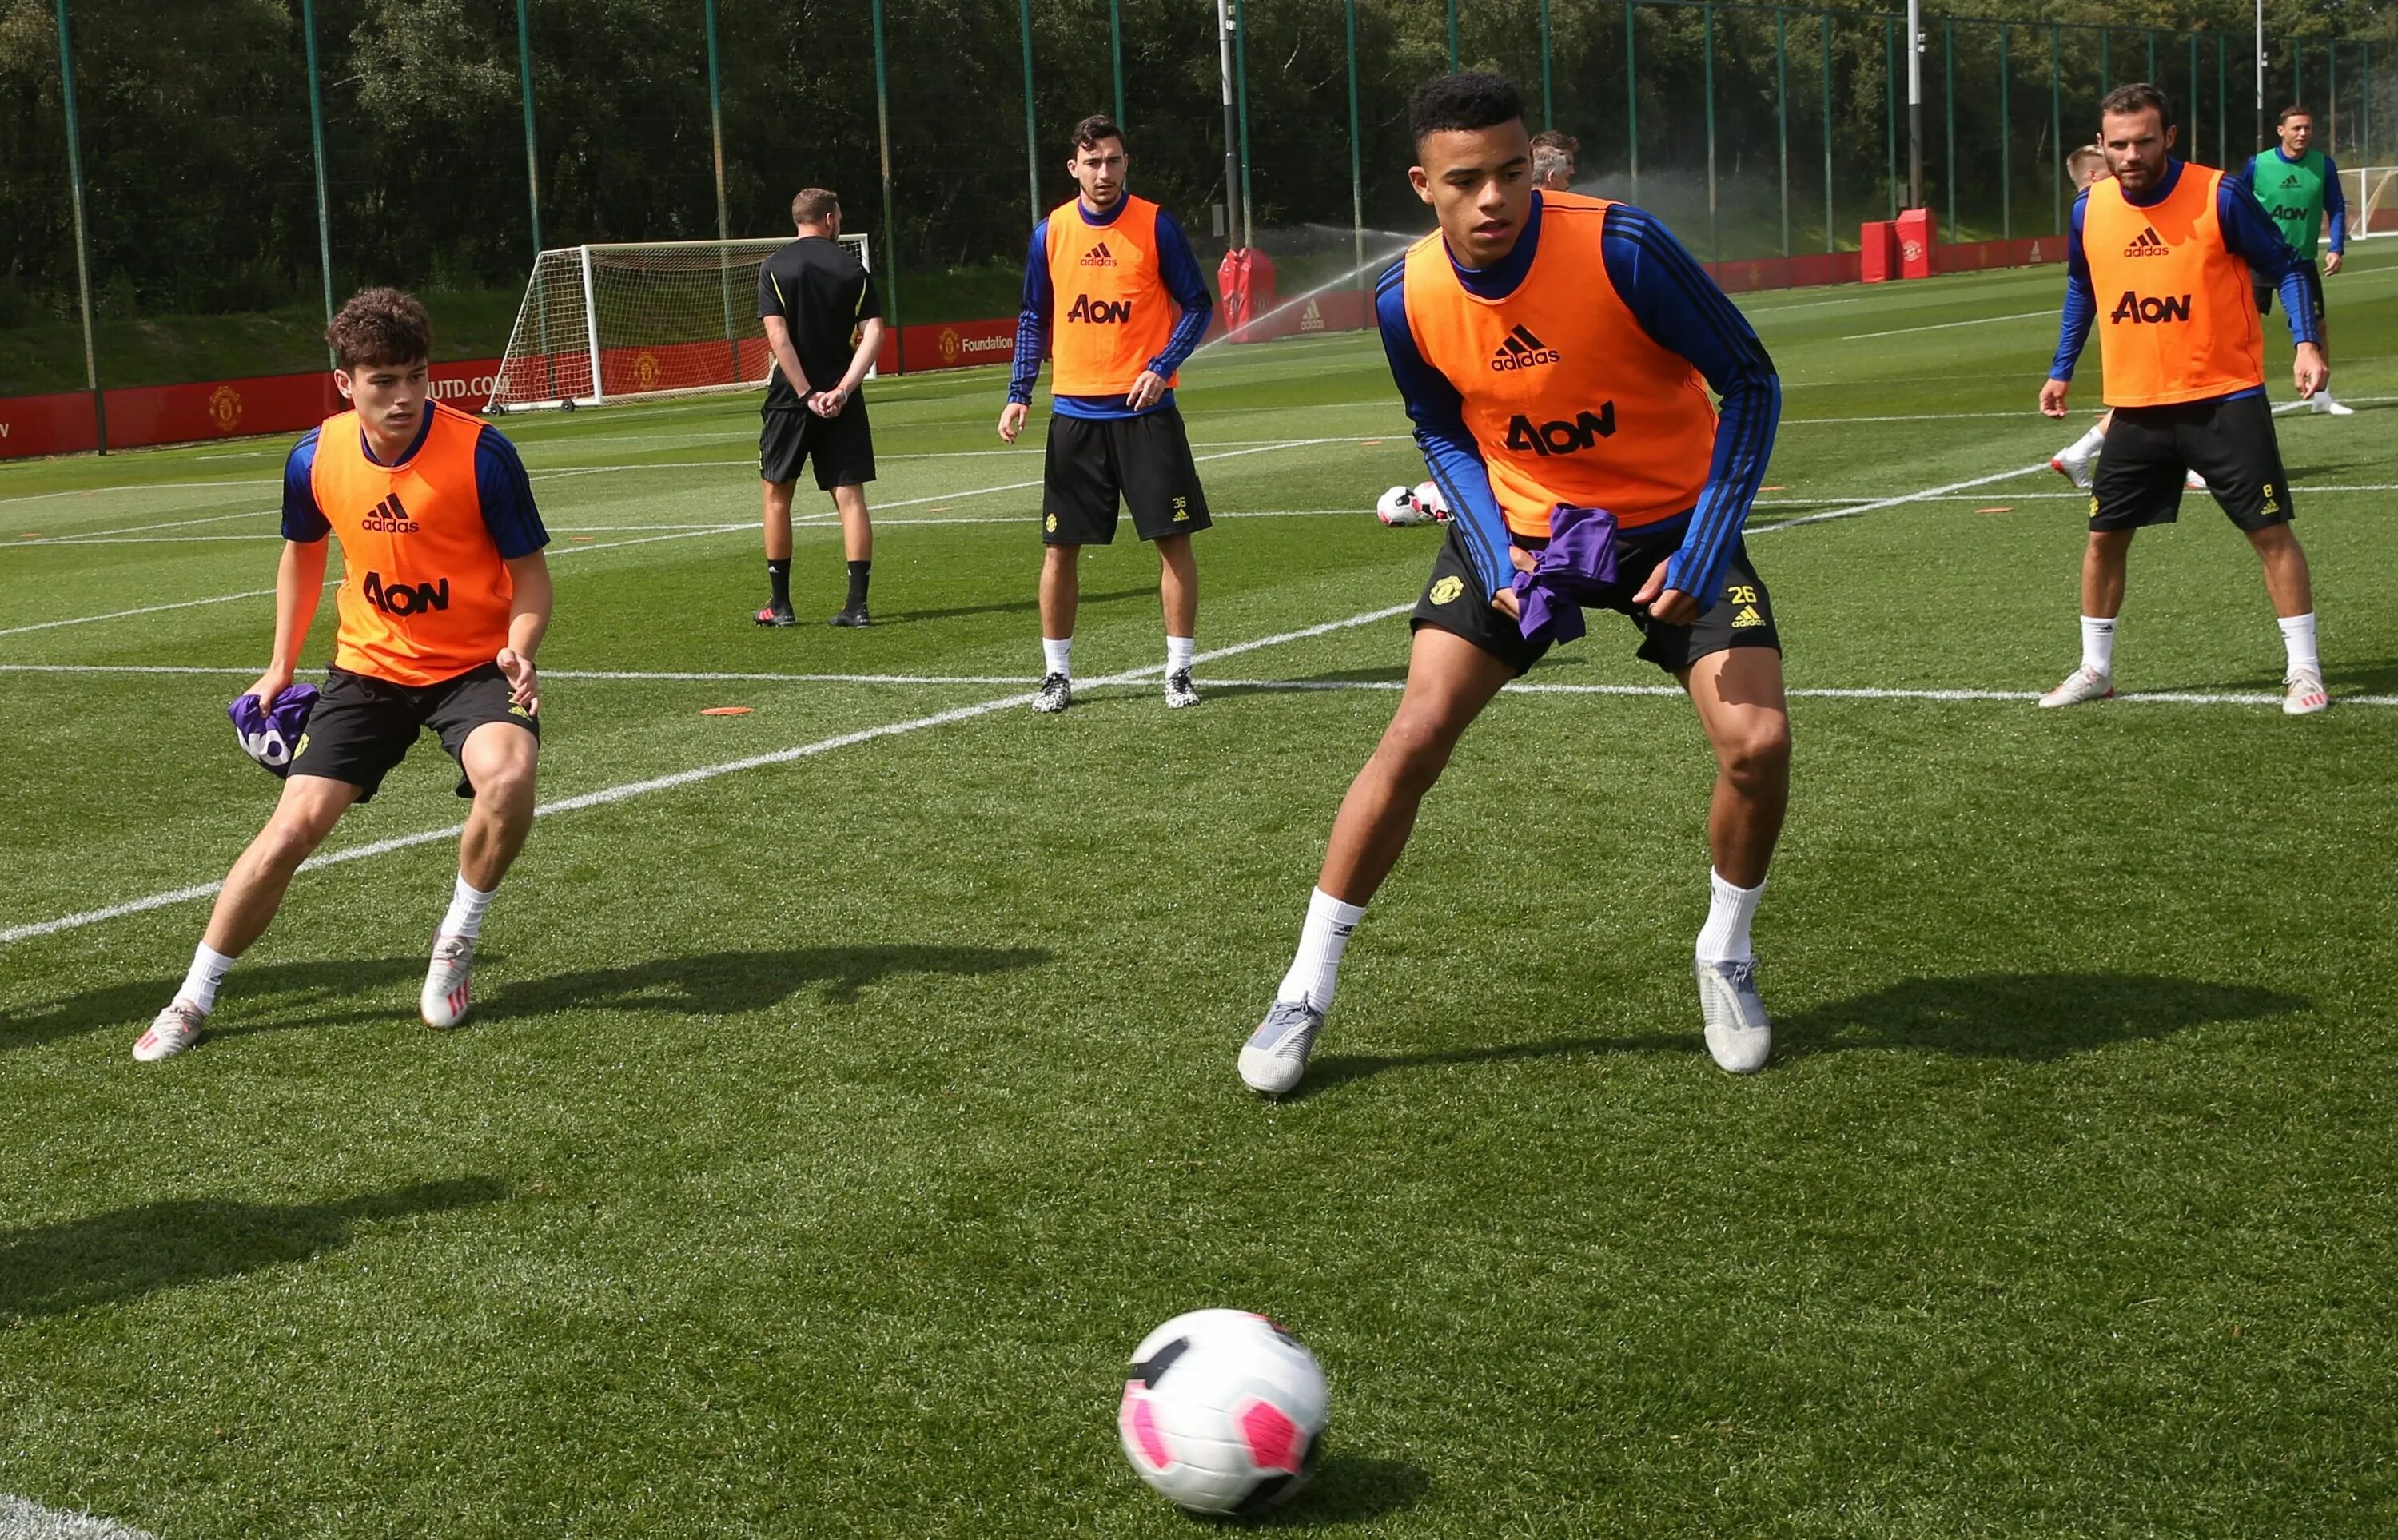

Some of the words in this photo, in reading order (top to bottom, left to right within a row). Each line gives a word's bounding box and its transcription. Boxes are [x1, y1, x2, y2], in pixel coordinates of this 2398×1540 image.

[2124, 246, 2169, 257] adidas
[1080, 257, 1117, 266] adidas
[962, 336, 1013, 352] Foundation
[1491, 348, 1560, 372] adidas
[1173, 497, 1186, 508] 36
[362, 518, 420, 533] adidas
[1728, 586, 1757, 604] 26
[1731, 619, 1766, 627] adidas
